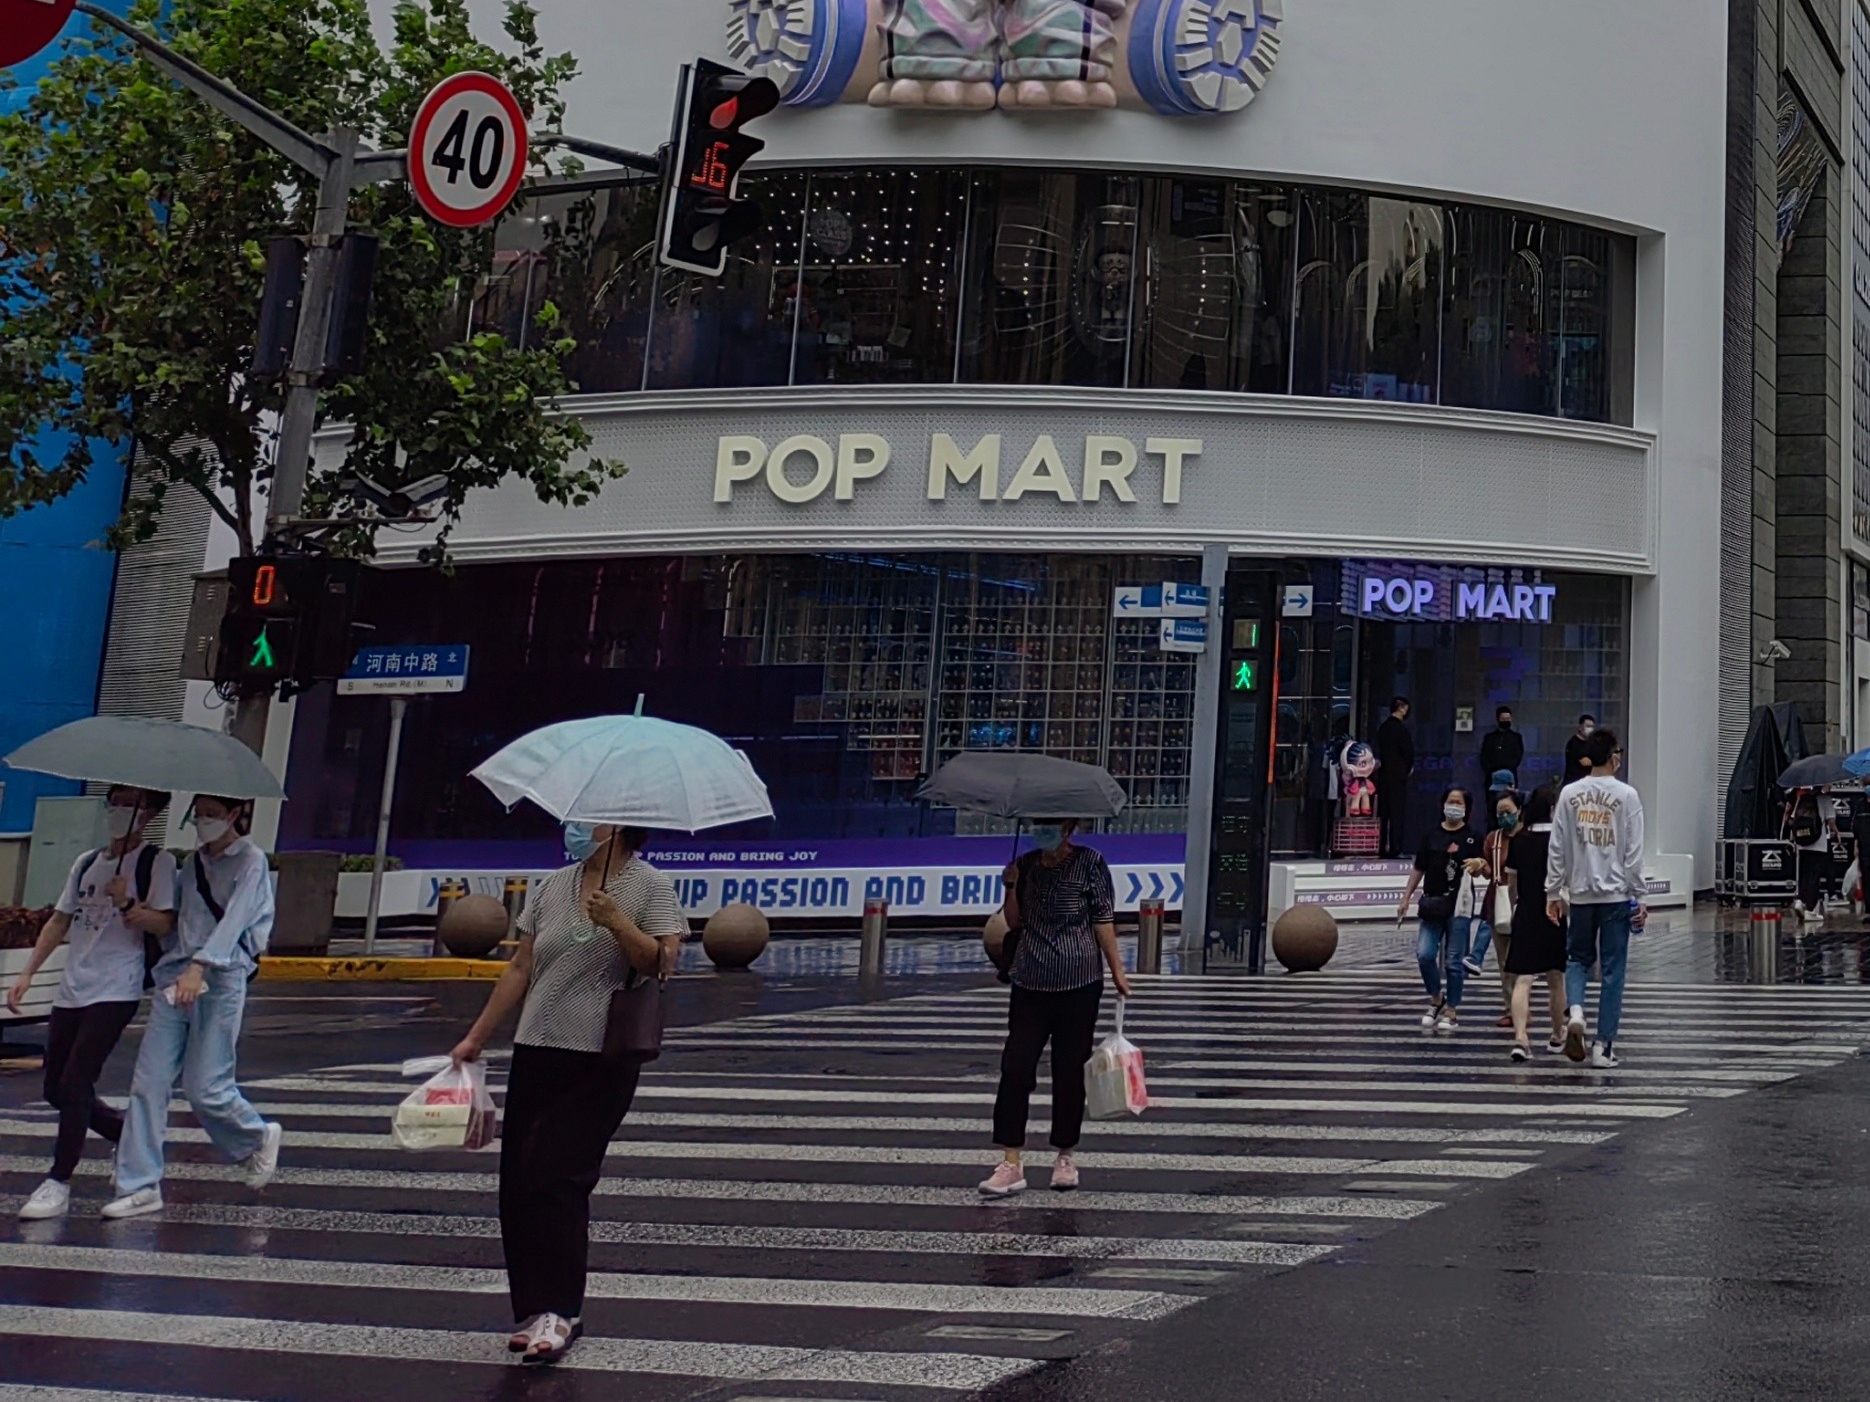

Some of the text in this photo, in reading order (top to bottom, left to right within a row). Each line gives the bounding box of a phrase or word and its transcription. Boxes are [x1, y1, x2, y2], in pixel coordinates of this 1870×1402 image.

[432, 108, 505, 190] 40
[713, 432, 1204, 505] POP MART
[1362, 577, 1556, 621] POP MART
[366, 652, 439, 674] 河南中路
[346, 681, 354, 691] S
[445, 679, 454, 689] N
[647, 851, 705, 862] PASSION
[709, 851, 736, 862] AND
[740, 850, 784, 862] BRING
[788, 850, 818, 861] JOY
[721, 876, 850, 908] PASSION
[864, 875, 926, 907] AND
